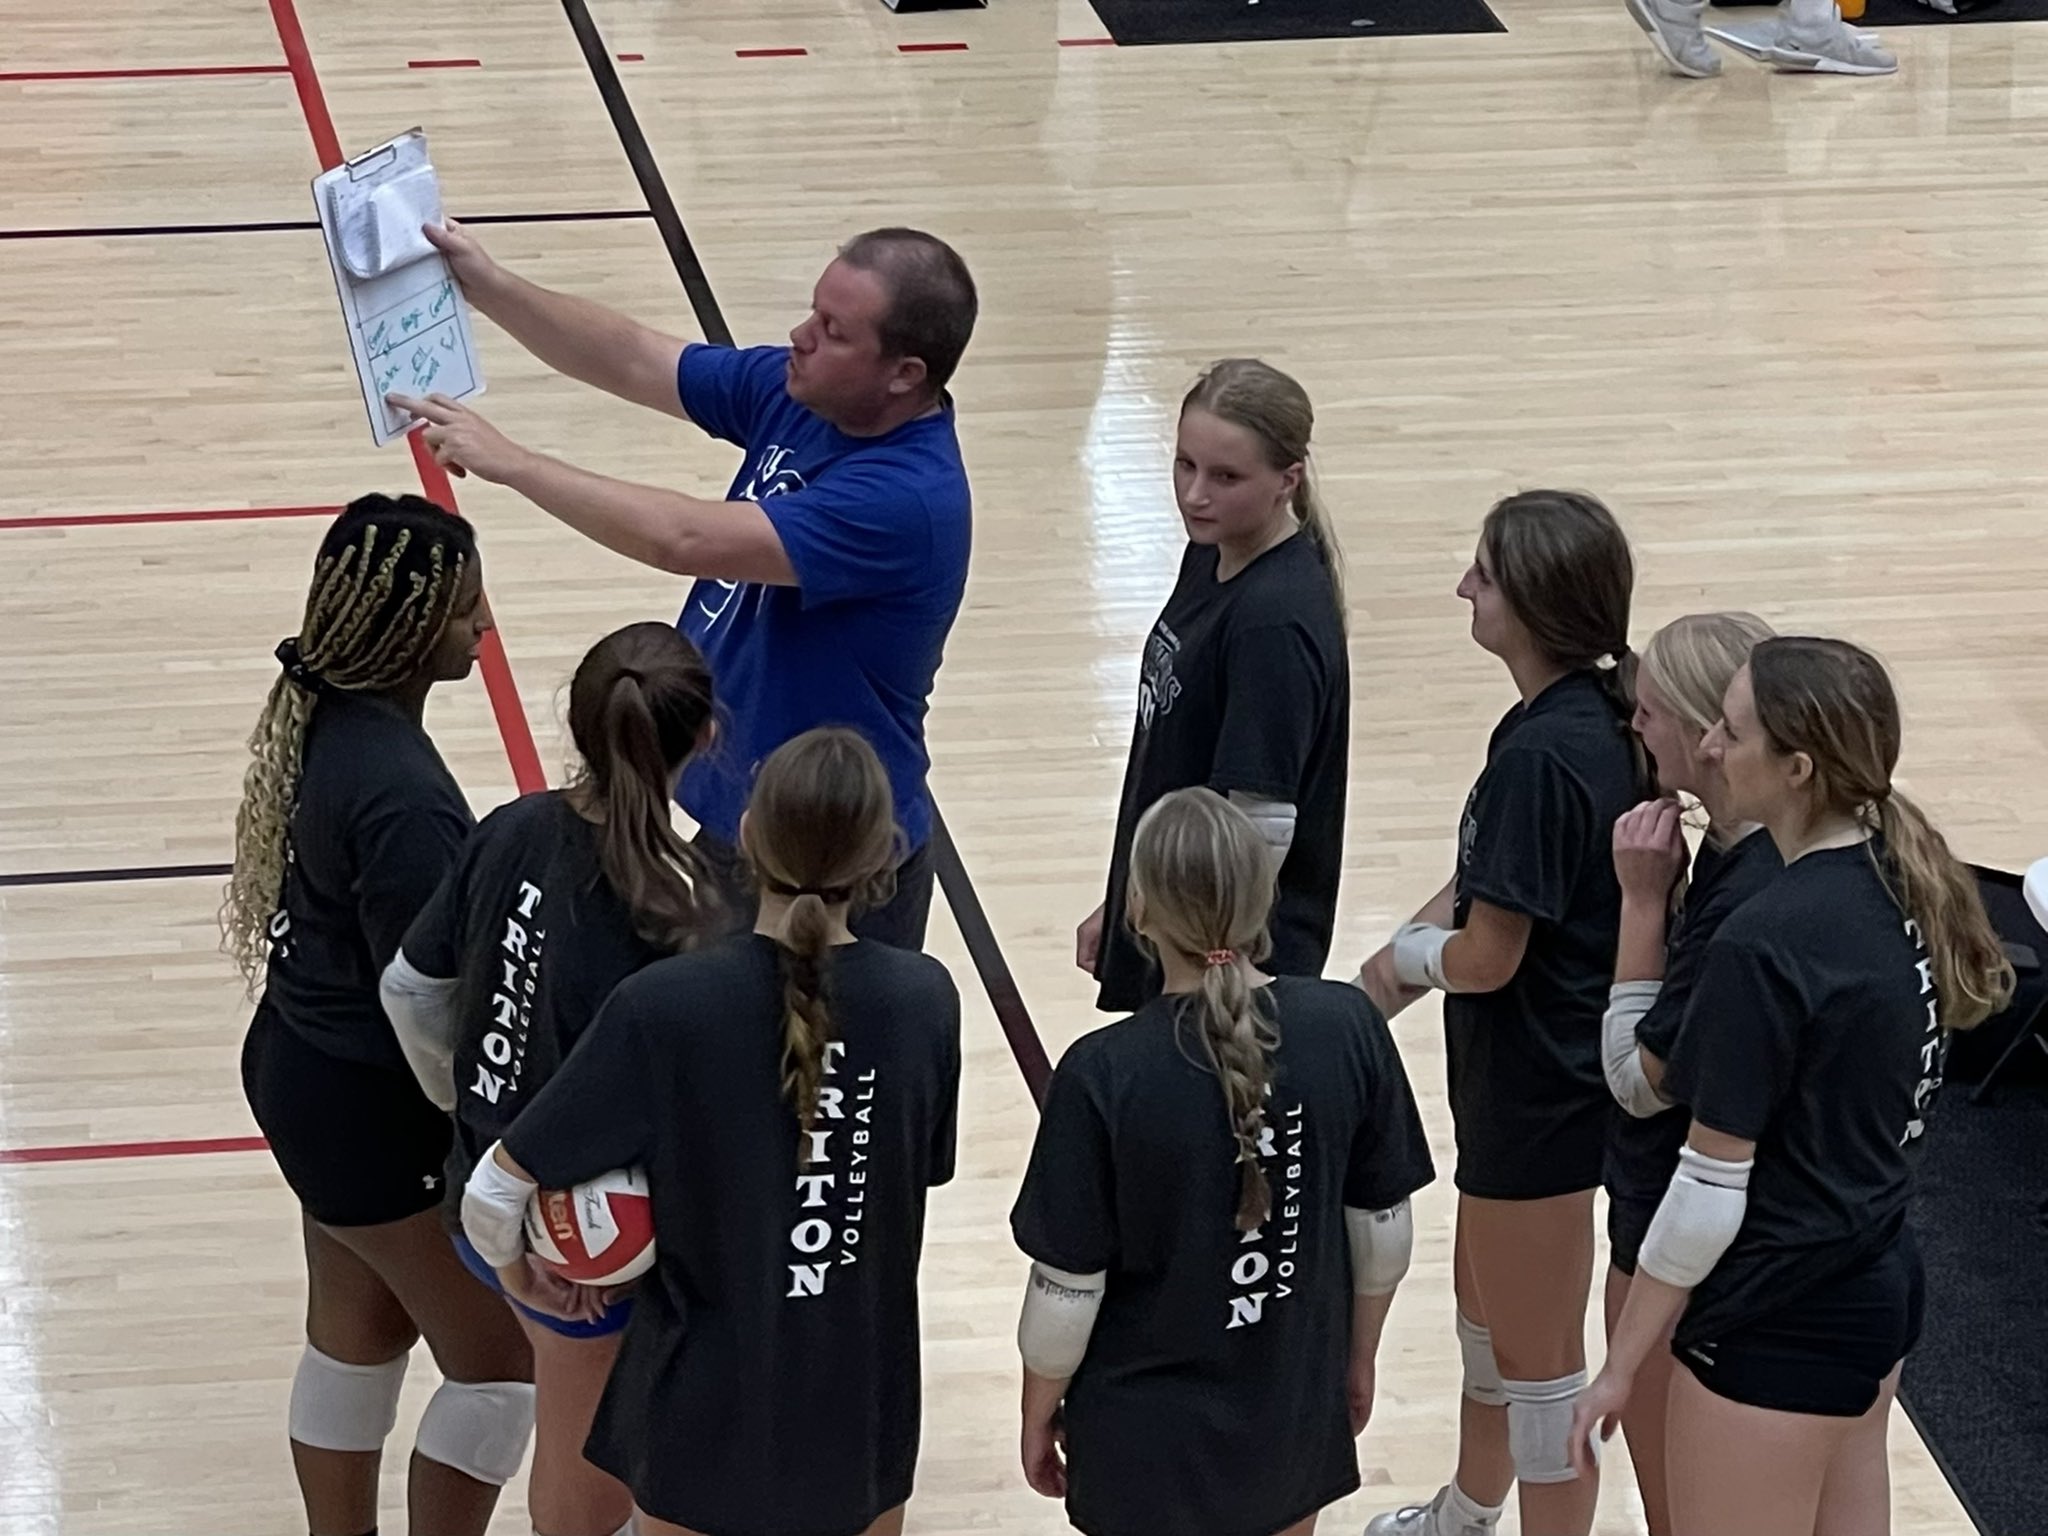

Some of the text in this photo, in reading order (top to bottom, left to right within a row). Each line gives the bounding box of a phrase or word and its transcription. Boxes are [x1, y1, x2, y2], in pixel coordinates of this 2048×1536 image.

[469, 880, 543, 1105] TRITON
[508, 928, 546, 1092] VOLLEYBALL
[840, 1068, 876, 1266] VOLLEYBALL
[1275, 1103, 1302, 1298] VOLLEYBALL
